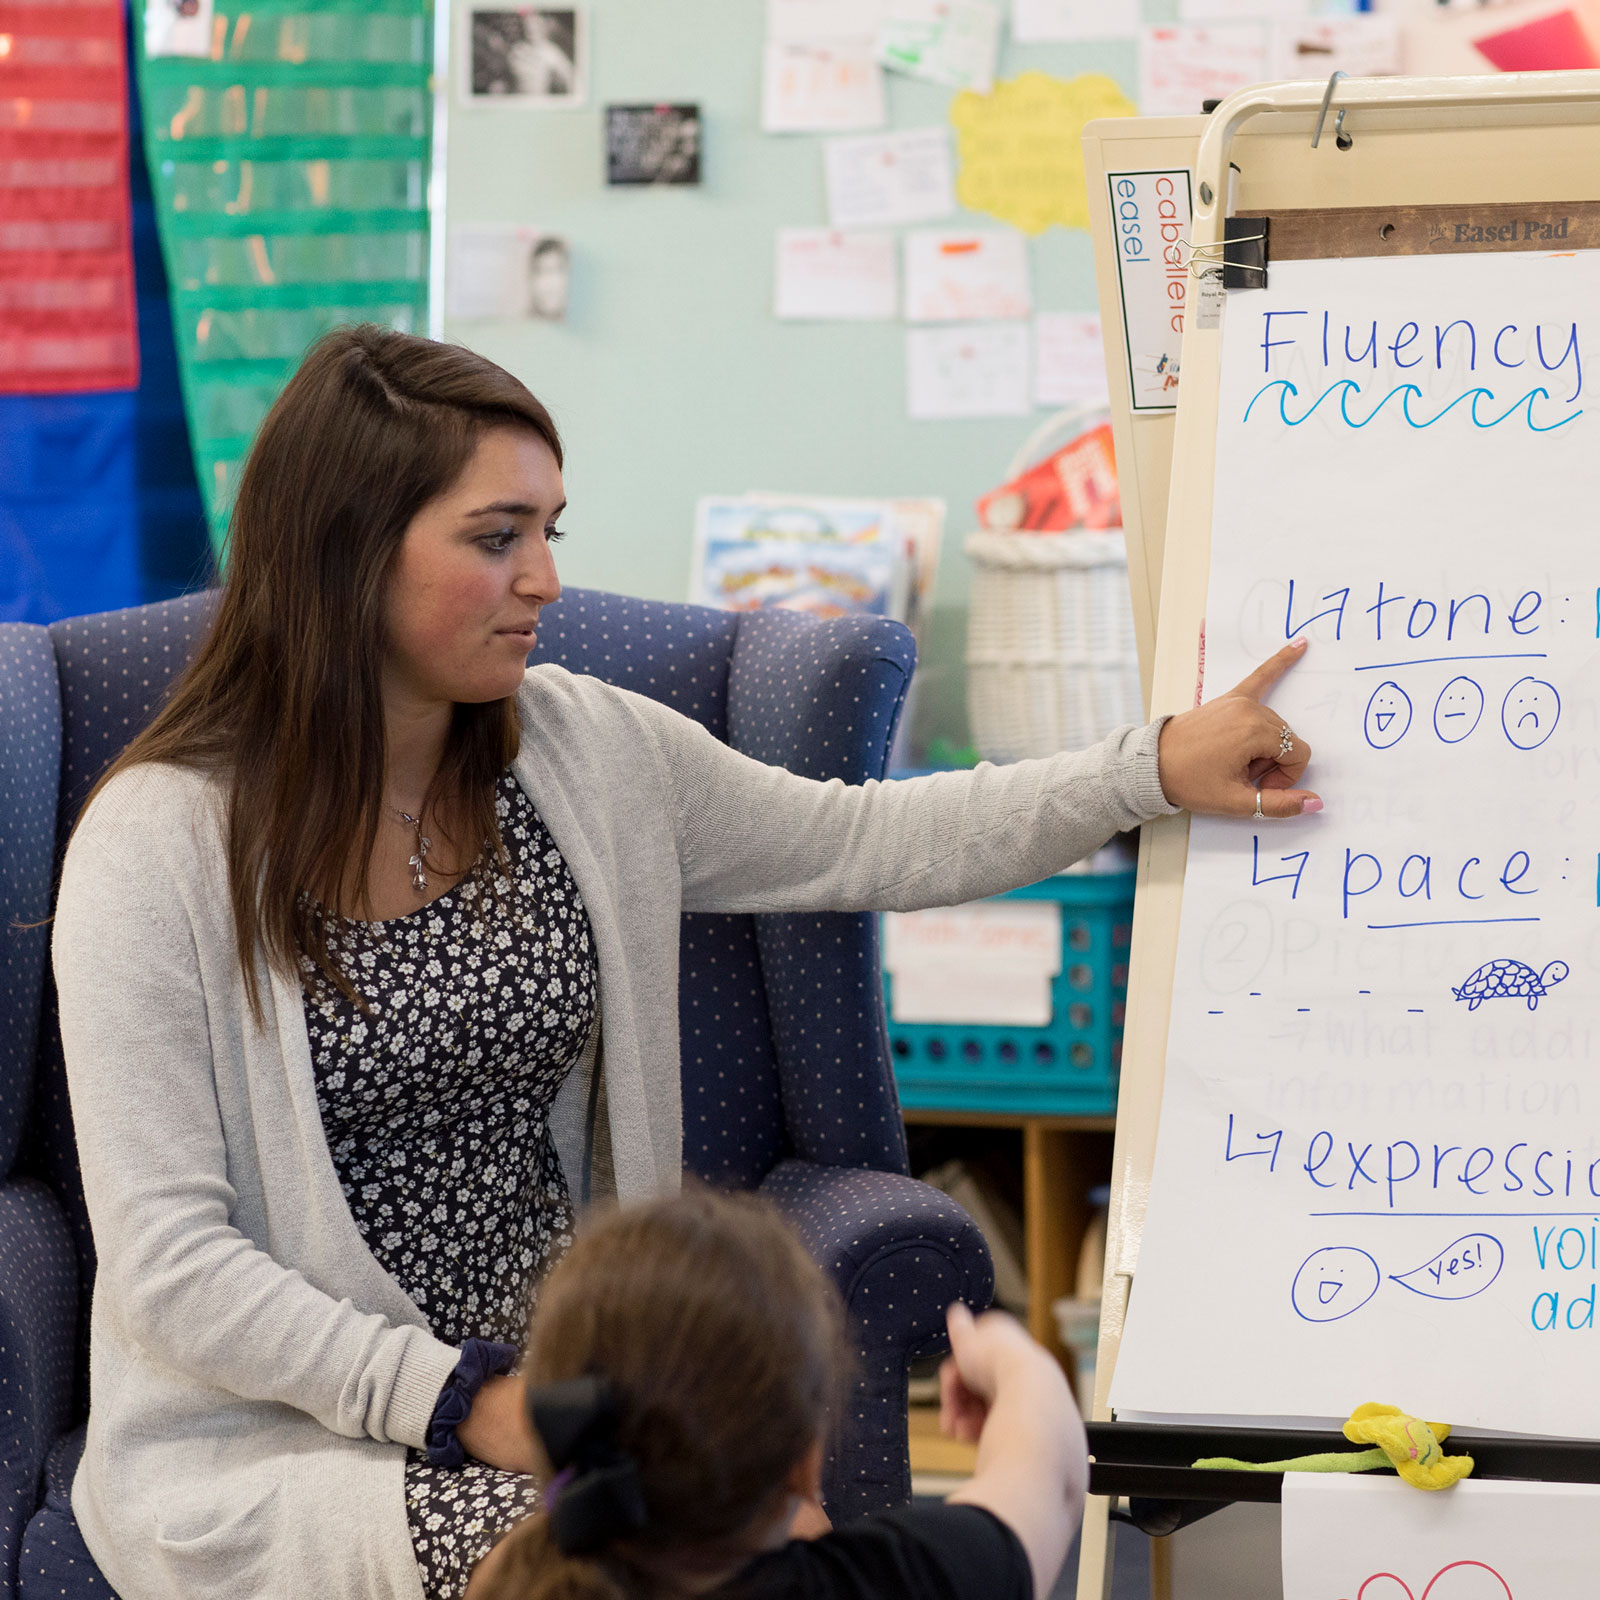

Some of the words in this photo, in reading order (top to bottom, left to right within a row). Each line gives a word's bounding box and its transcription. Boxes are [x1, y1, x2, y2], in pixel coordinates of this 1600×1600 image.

[1117, 179, 1150, 262] easel
[1454, 219, 1518, 243] Easel
[1523, 217, 1569, 240] Pad
[1155, 177, 1188, 333] caballete
[1260, 310, 1582, 403] Fluency
[1428, 1243, 1483, 1285] yes!
[1533, 1217, 1600, 1270] voi
[1531, 1283, 1596, 1331] ad
